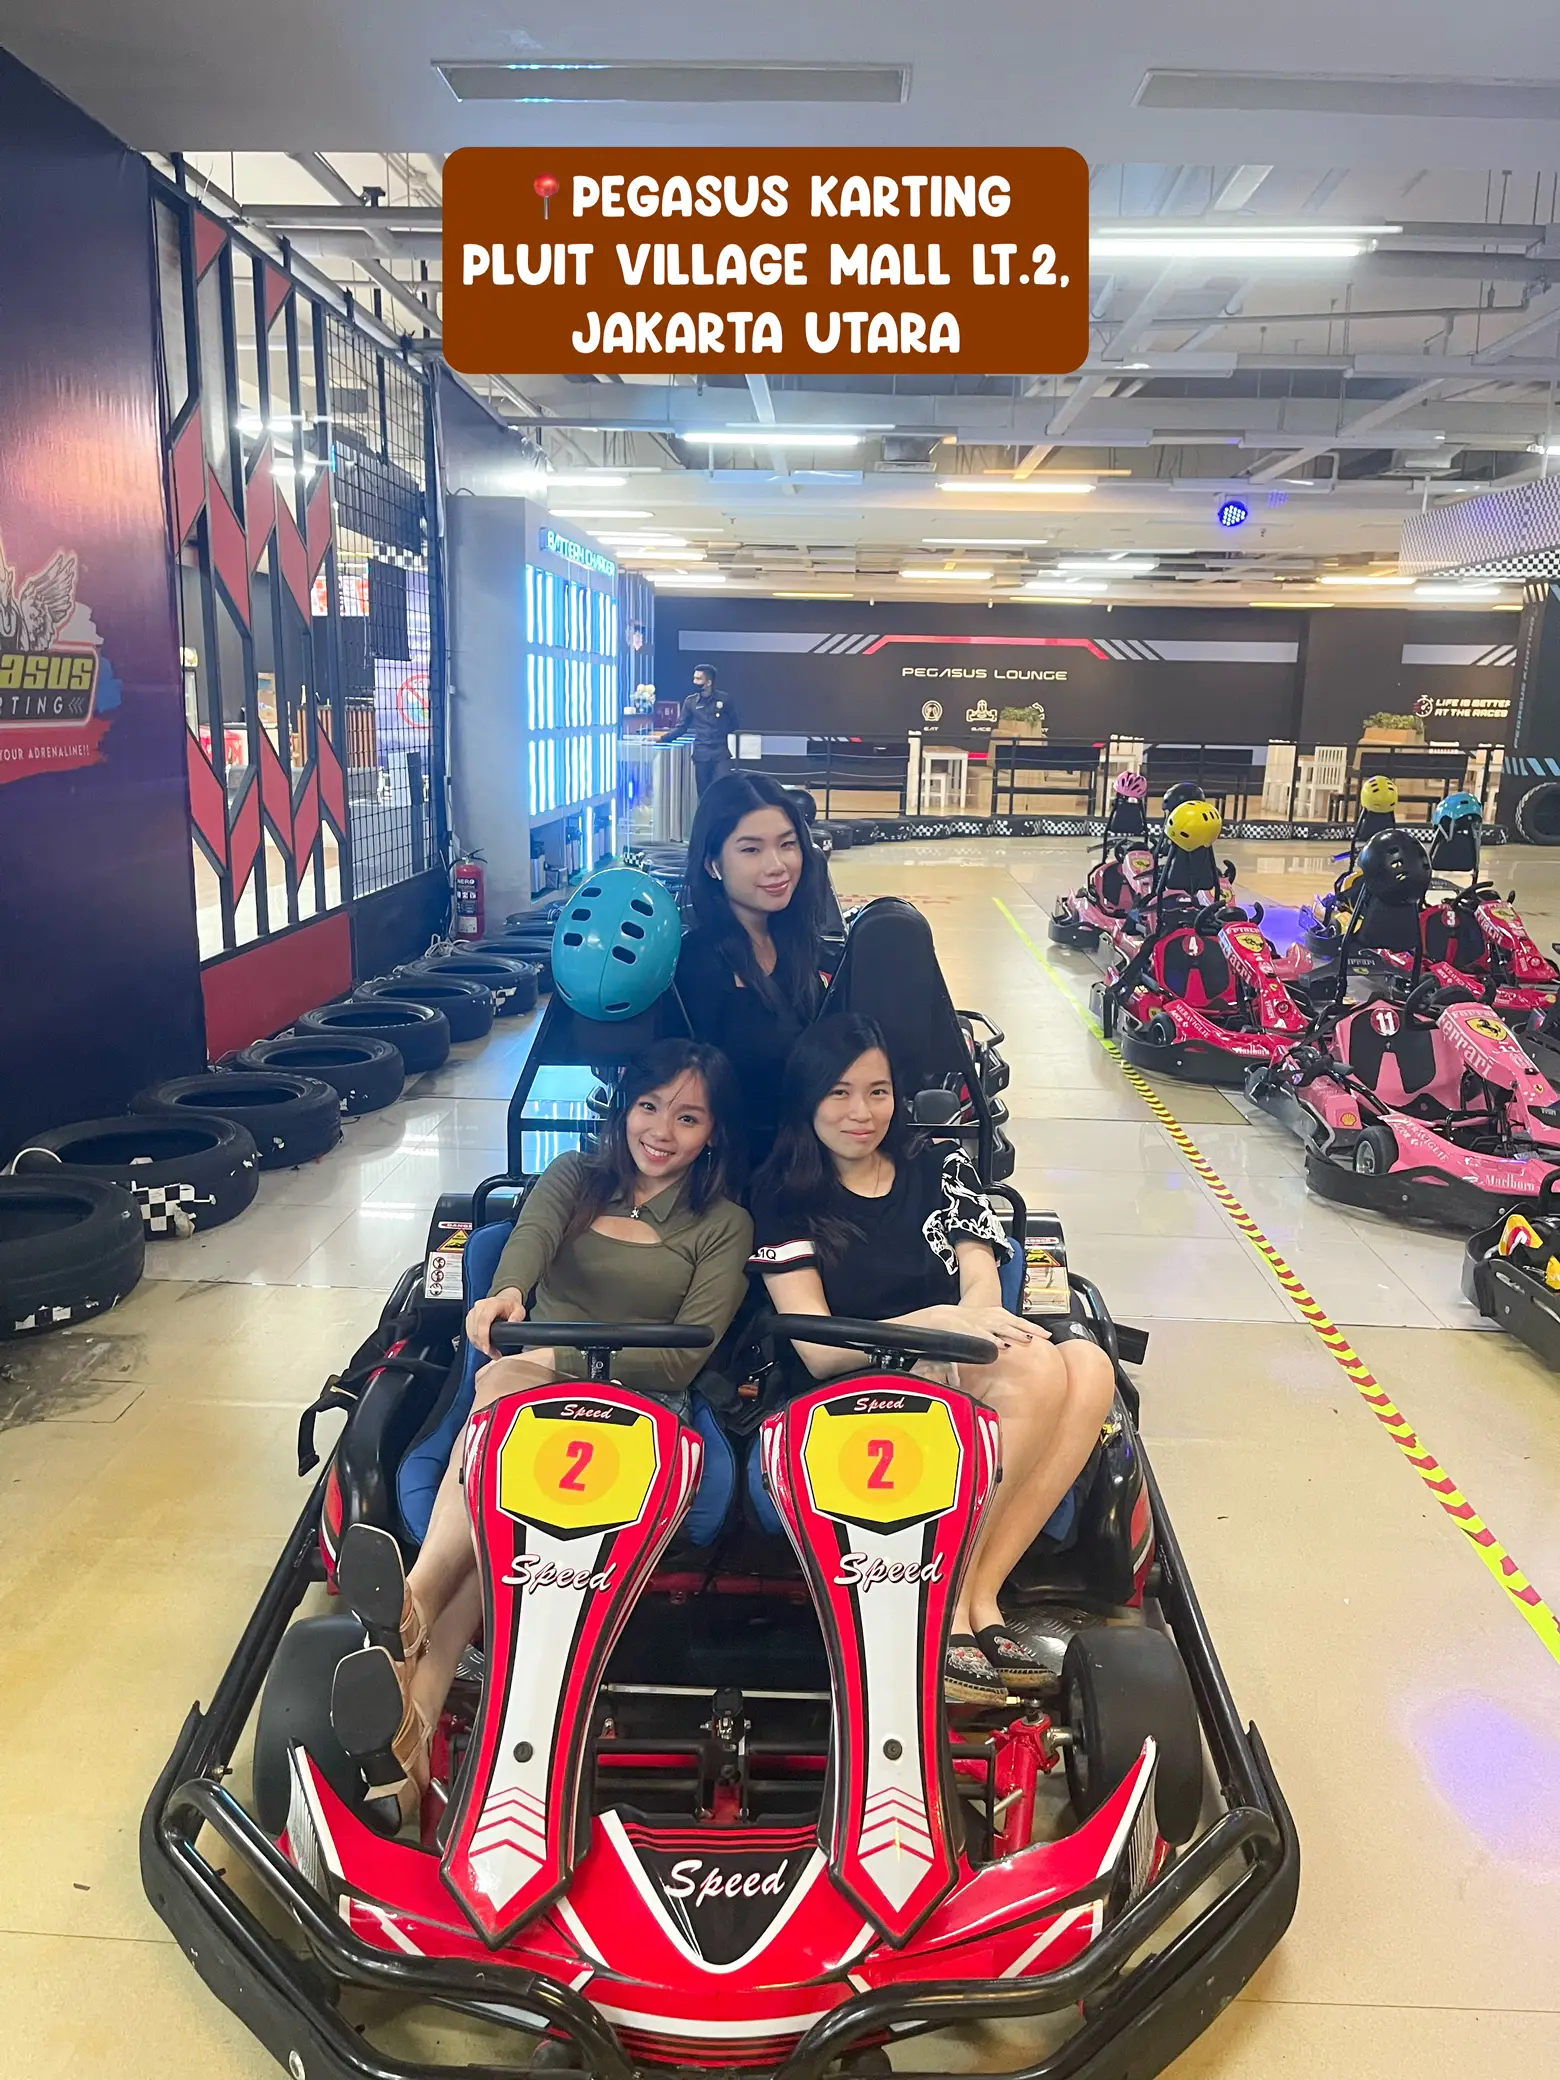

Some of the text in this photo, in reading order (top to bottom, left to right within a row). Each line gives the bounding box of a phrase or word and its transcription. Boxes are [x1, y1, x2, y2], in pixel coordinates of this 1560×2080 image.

[902, 667, 1068, 681] PEGASUS LOUNGE
[1435, 698, 1460, 707] LIFE
[1434, 708, 1449, 717] AT
[1450, 708, 1471, 718] THE
[28, 744, 90, 759] ADRENALINE!!
[1447, 911, 1456, 927] 3
[1188, 936, 1198, 956] 4
[1376, 1012, 1395, 1036] 11
[1441, 1016, 1495, 1079] errari
[1485, 1172, 1535, 1191] Marlboro
[560, 1403, 614, 1420] Speed
[853, 1396, 905, 1413] Speed
[558, 1440, 595, 1492] 2
[867, 1439, 895, 1490] 2
[501, 1553, 618, 1595] Speed
[833, 1551, 946, 1594] Speed
[665, 1858, 789, 1908] Speed
